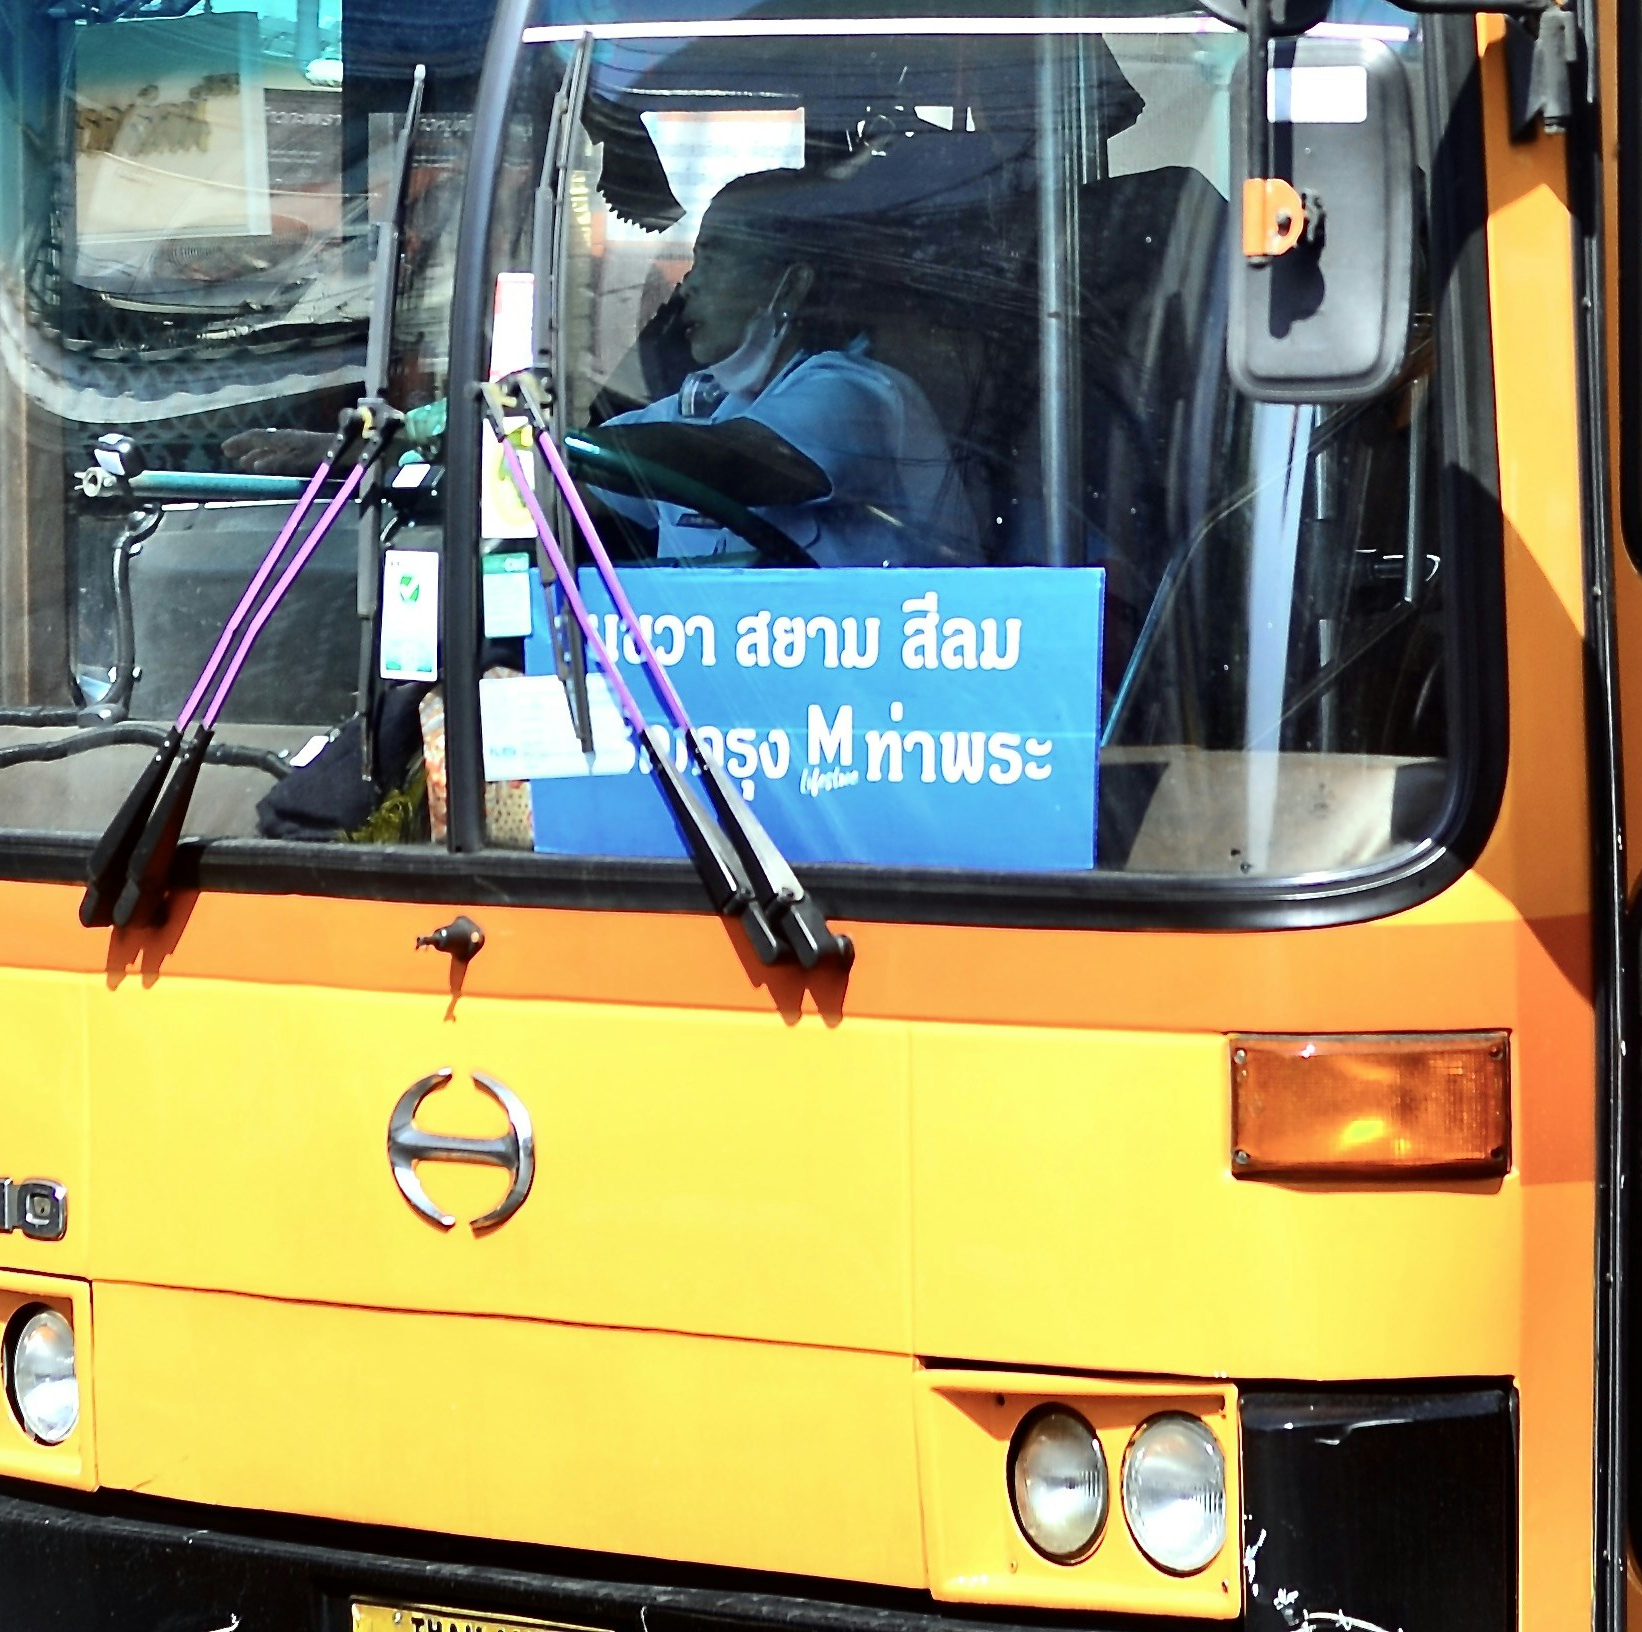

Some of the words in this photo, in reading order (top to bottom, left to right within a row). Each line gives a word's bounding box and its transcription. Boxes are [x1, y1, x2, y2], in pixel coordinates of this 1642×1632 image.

[735, 610, 881, 669] สยาม
[901, 591, 1023, 670] สีลม
[807, 704, 854, 767] M
[865, 701, 1053, 784] ท่าพระ
